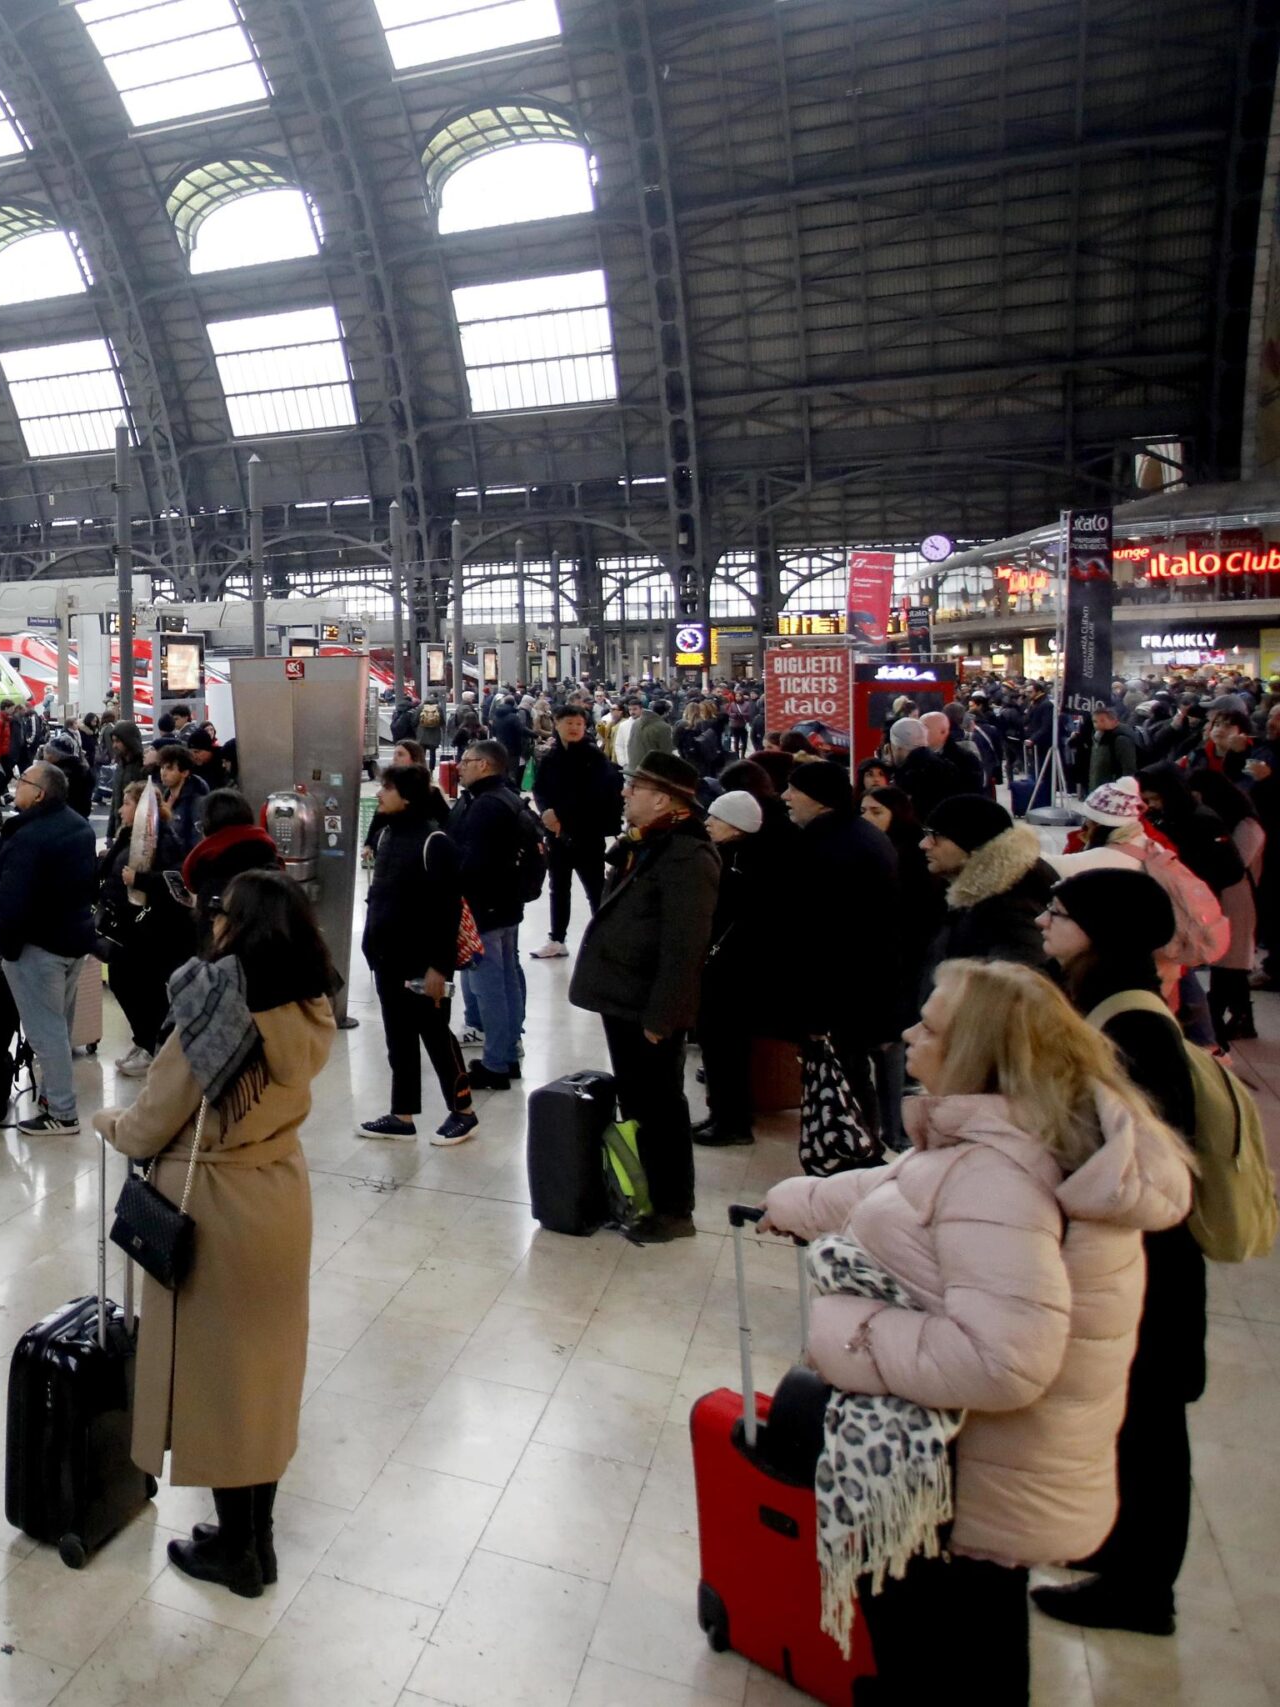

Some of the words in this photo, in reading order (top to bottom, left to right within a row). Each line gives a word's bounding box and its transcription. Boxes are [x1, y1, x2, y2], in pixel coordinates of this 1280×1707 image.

[1113, 546, 1150, 561] unge
[1226, 548, 1280, 573] Club
[1140, 632, 1217, 648] FRANKLY
[773, 655, 843, 674] BIGLIETTI
[778, 677, 837, 694] TICKETS
[134, 715, 142, 723] 10
